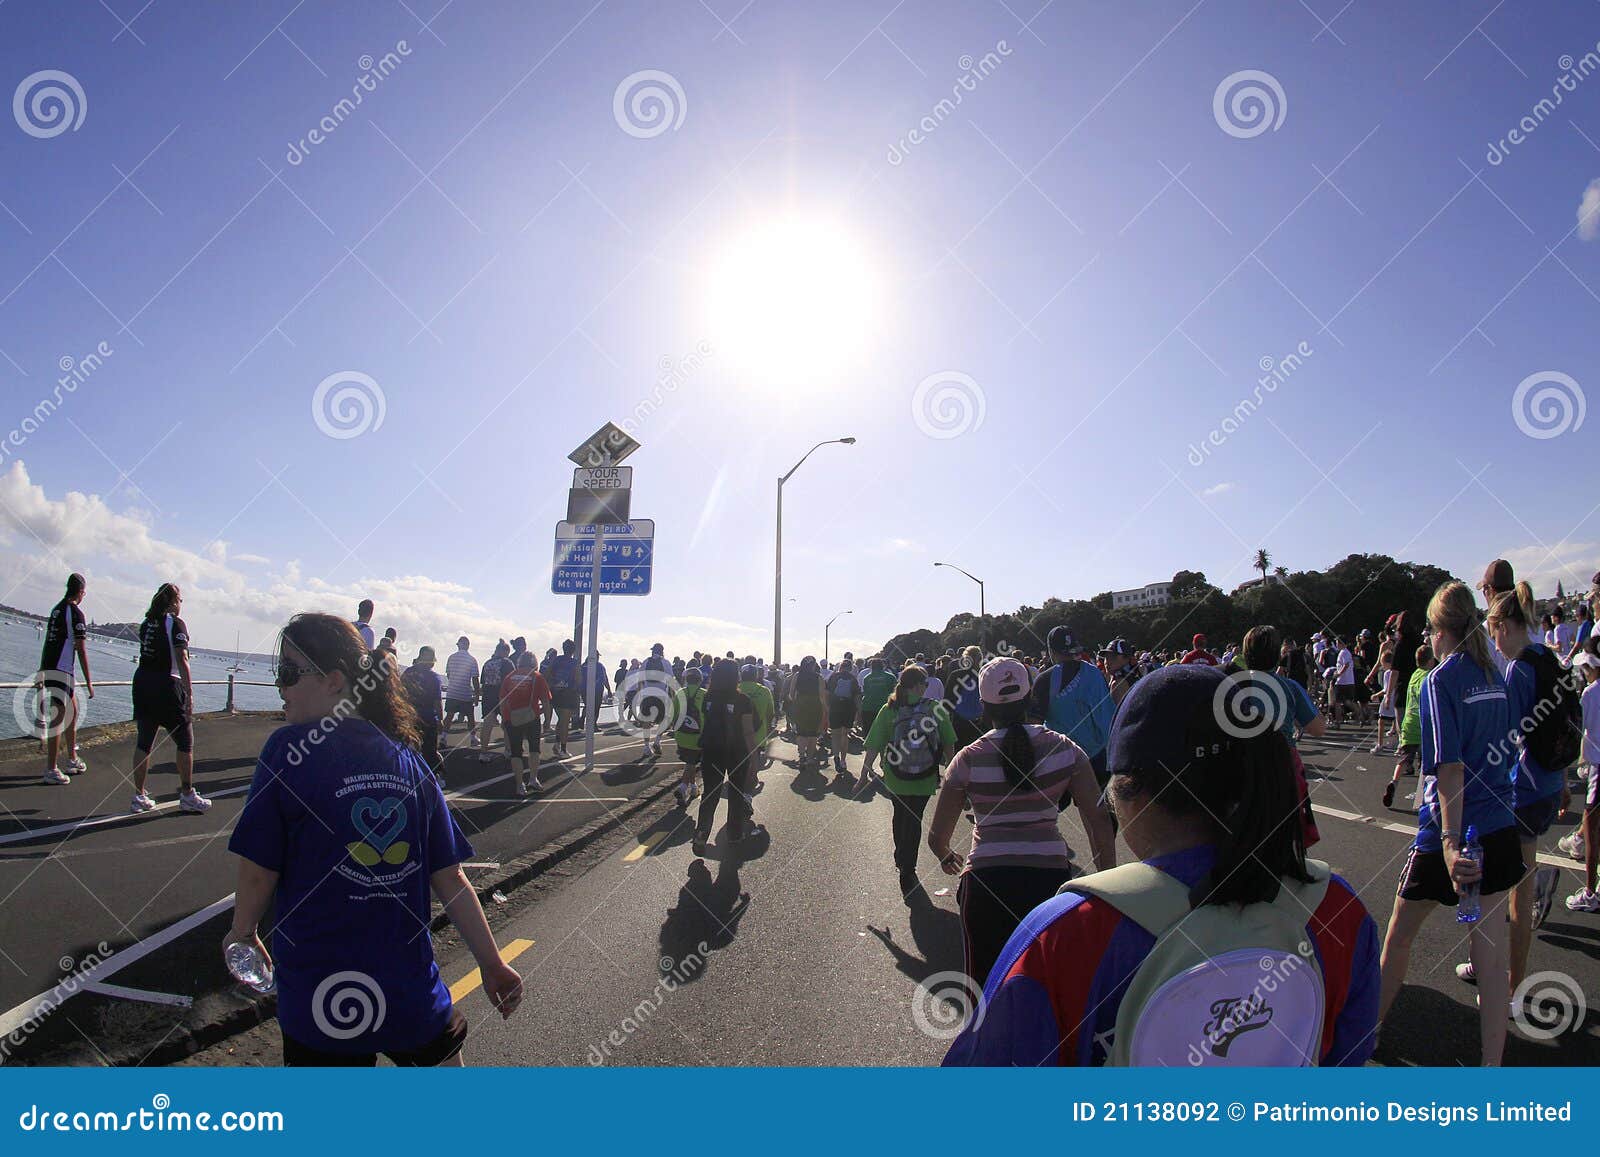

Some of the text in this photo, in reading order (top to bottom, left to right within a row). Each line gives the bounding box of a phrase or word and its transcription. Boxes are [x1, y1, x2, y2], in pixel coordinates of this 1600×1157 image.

[588, 468, 619, 478] YOUR
[583, 479, 622, 488] SPEED
[576, 581, 627, 590] Welngton
[375, 773, 389, 781] THE
[373, 781, 397, 790] BETTER
